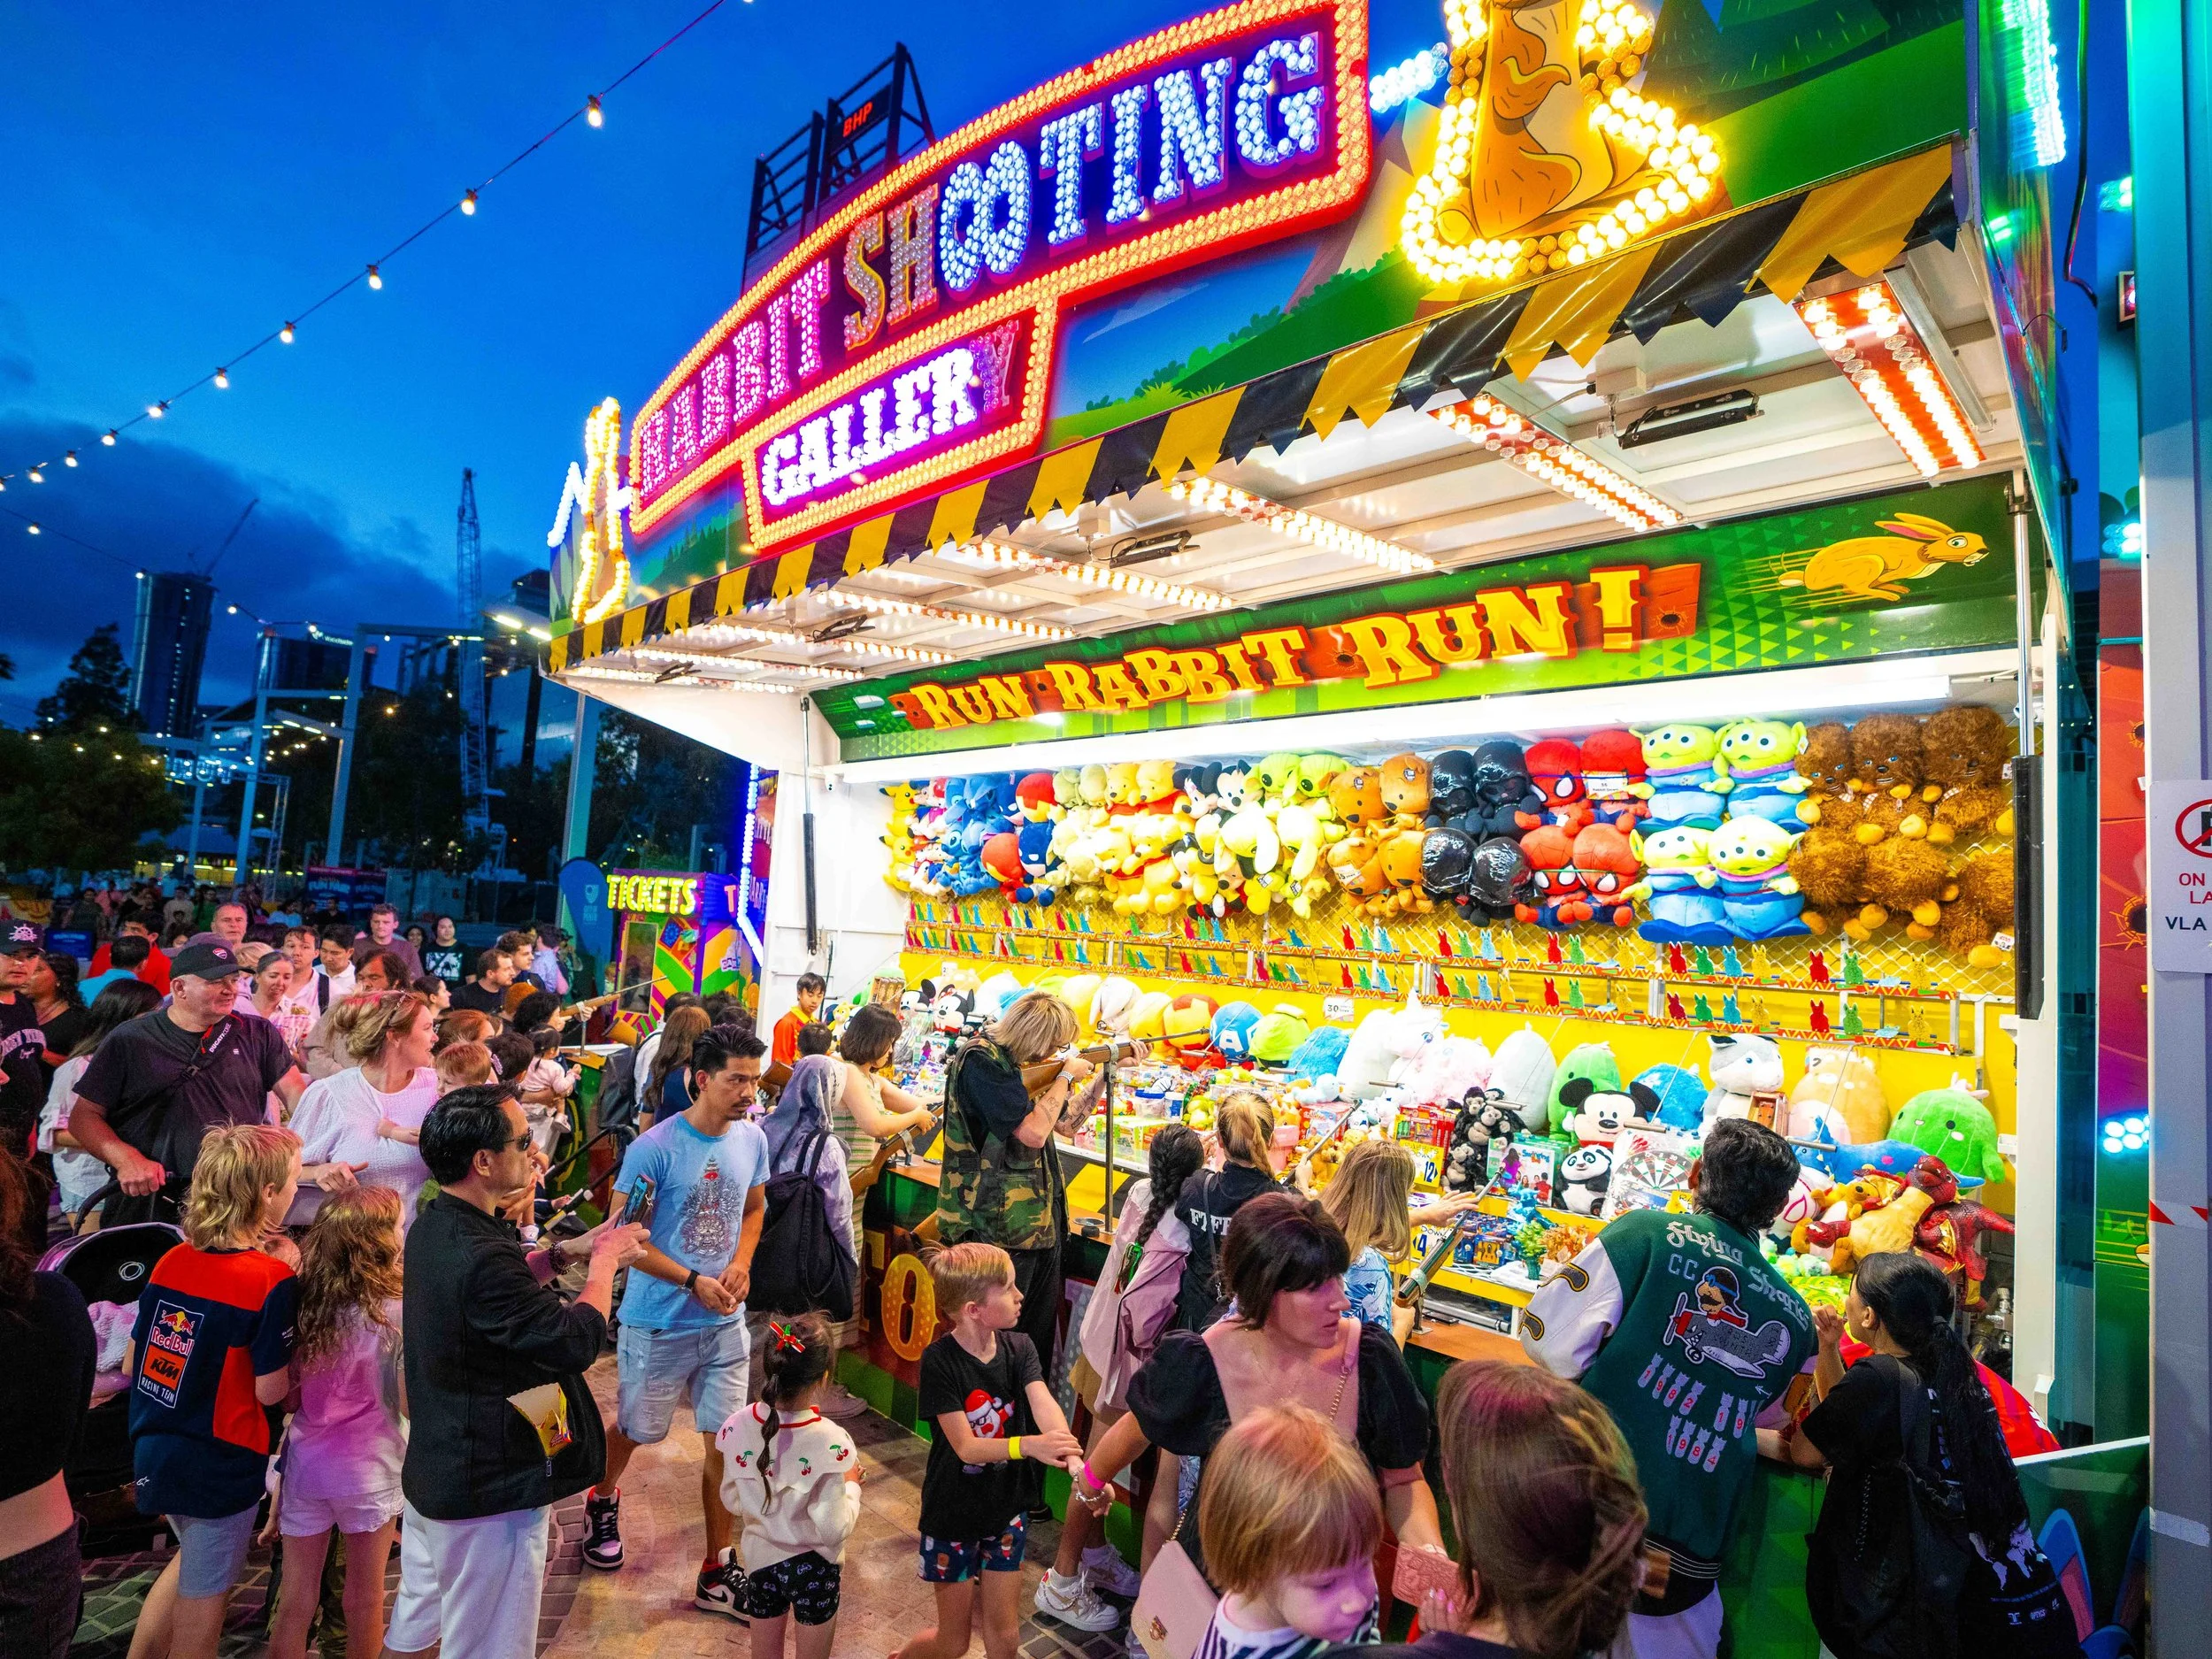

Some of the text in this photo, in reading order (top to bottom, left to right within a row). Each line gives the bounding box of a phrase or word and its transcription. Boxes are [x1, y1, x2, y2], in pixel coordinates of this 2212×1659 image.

[841, 101, 874, 138] BHP
[637, 32, 1325, 503] RABBIT SHOOTING
[760, 320, 1021, 507] GALLERY
[909, 674, 1028, 731] RUN
[1054, 625, 1309, 713] RABBIT
[1342, 580, 1575, 688] RUN
[607, 873, 697, 916] TICKETS
[2178, 872, 2206, 887] ON
[2165, 916, 2208, 931] VLA
[1423, 1161, 1435, 1183] 12
[1666, 1220, 1809, 1332] Flying Sharks
[150, 1356, 180, 1381] KTM
[141, 1376, 176, 1404] RACING TEAM
